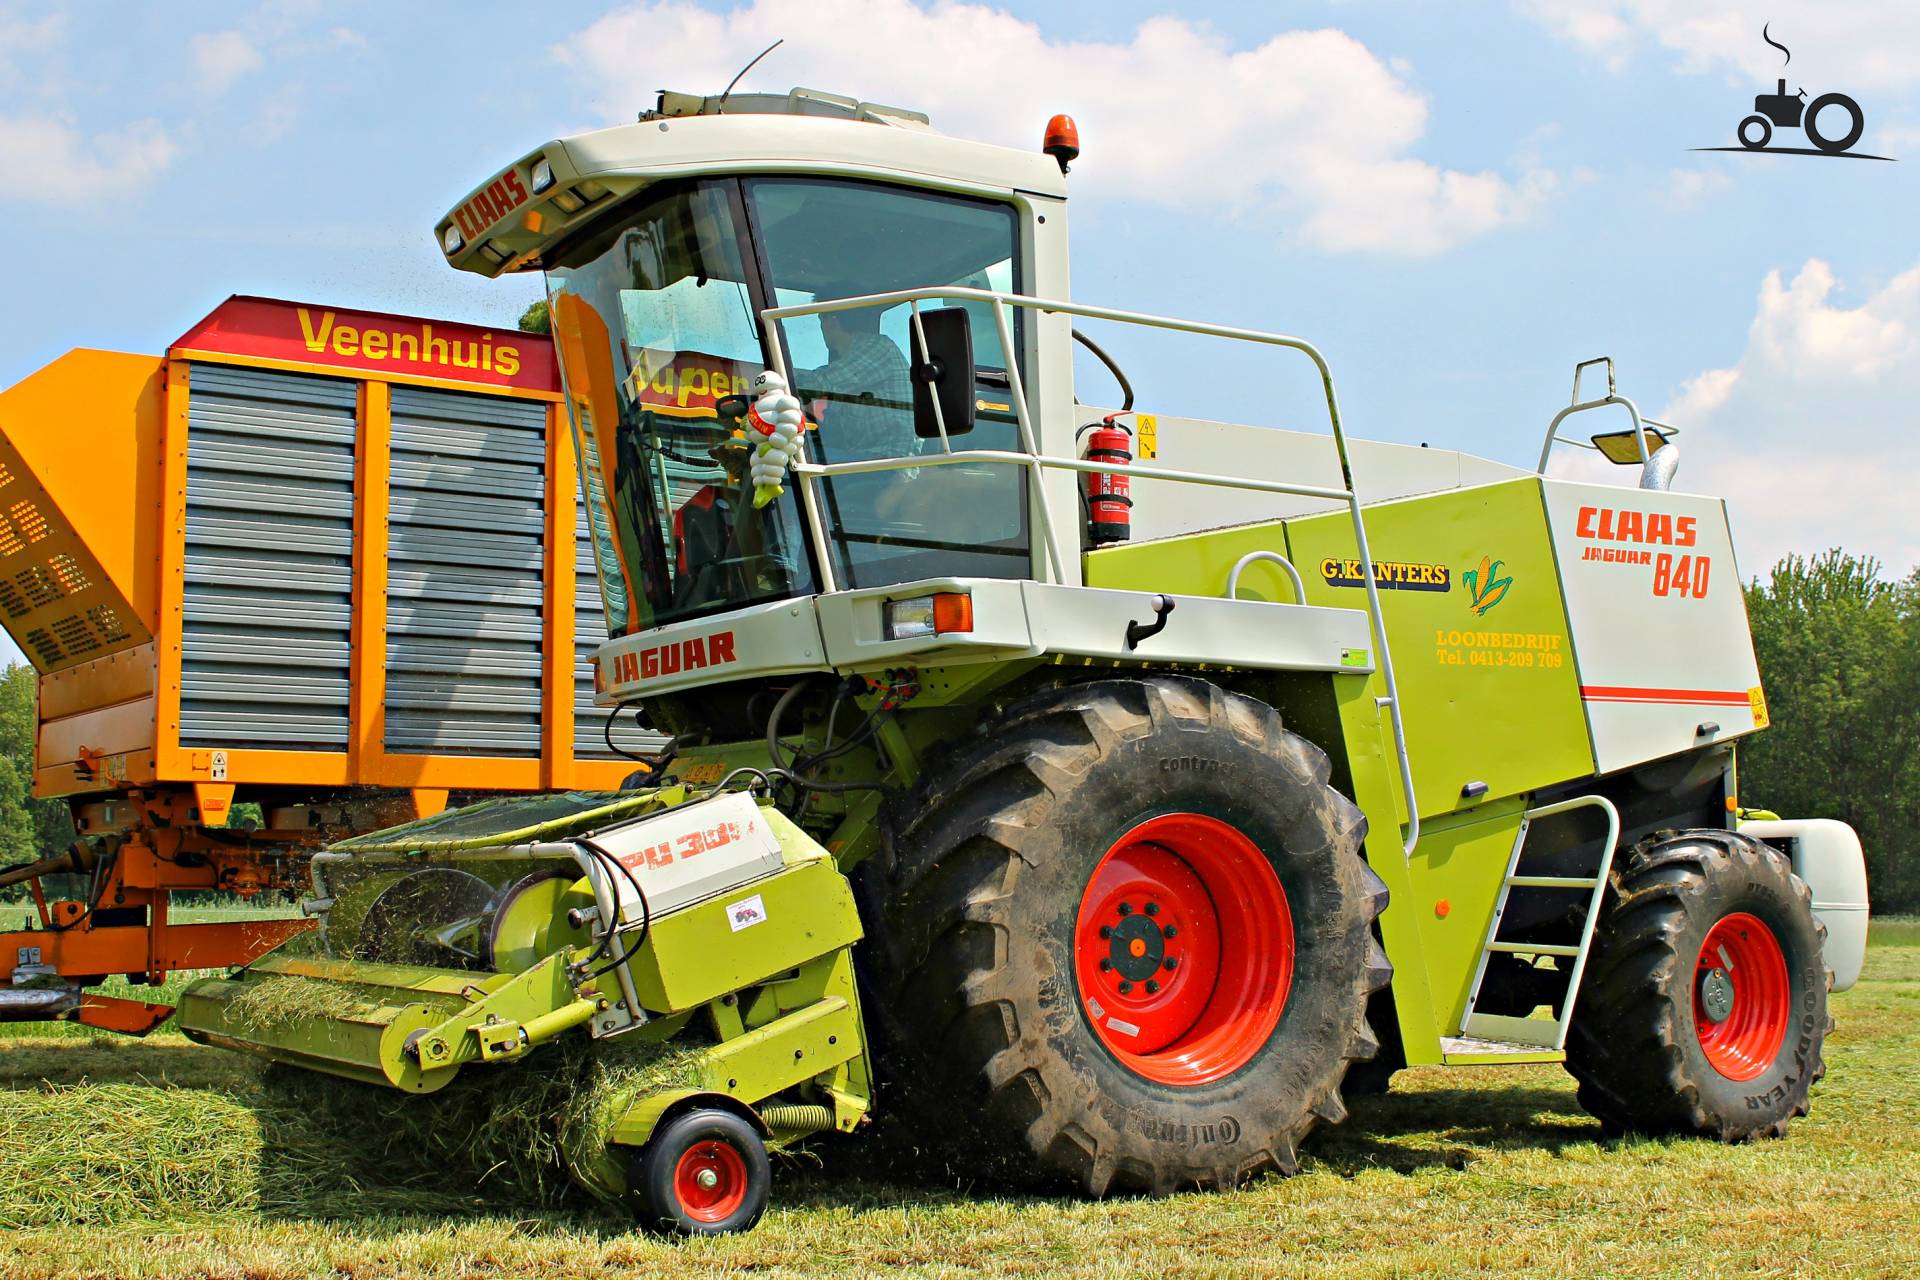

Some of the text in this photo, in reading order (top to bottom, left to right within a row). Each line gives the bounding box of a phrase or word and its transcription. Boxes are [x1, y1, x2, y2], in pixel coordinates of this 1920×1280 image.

[454, 169, 528, 241] CLAAS
[297, 308, 520, 376] Veenhuis
[1576, 506, 1697, 547] CLAAS
[1320, 558, 1447, 585] G.KNTERS
[1582, 547, 1711, 599] JAGUAR 840
[613, 631, 737, 685] JAGUAR
[1436, 630, 1561, 652] LOONBEDRIJF
[1437, 648, 1562, 668] Tel. 0413-209 709
